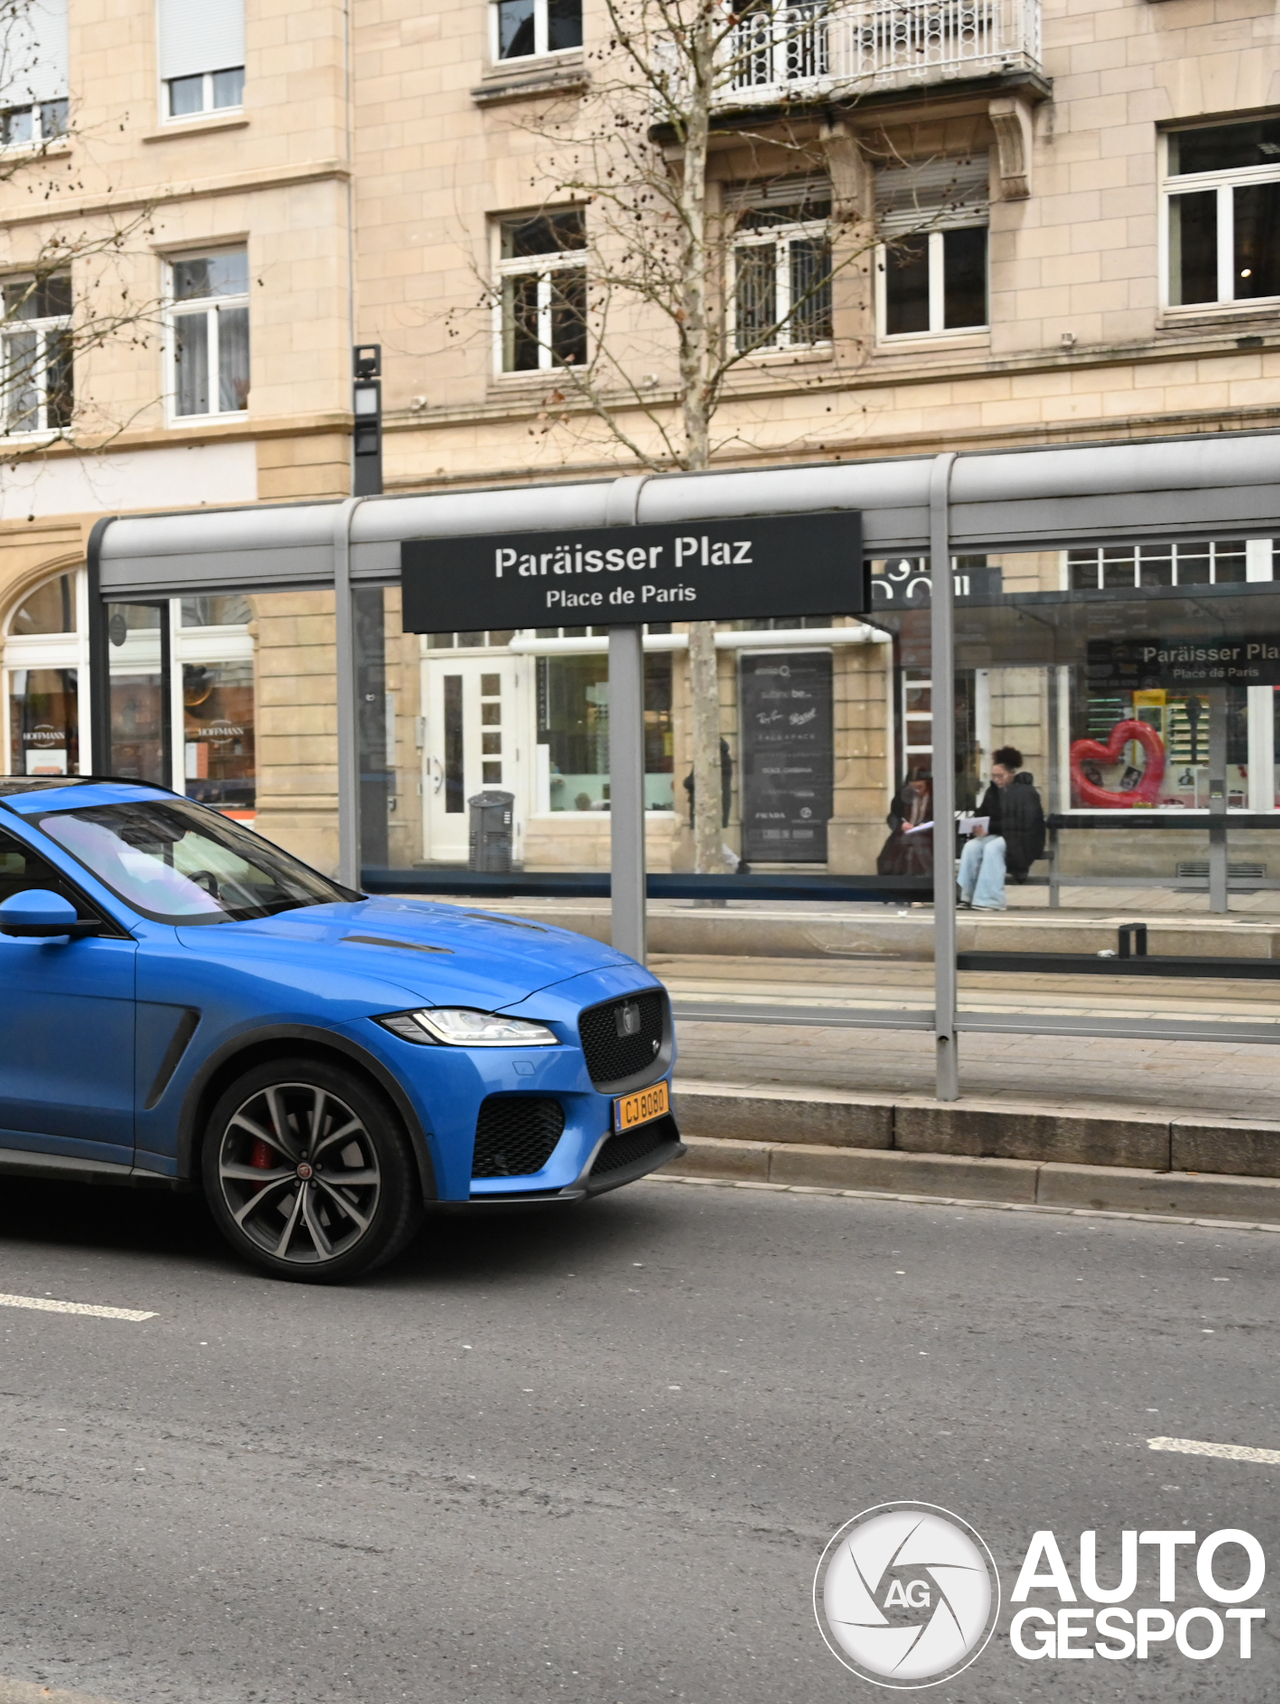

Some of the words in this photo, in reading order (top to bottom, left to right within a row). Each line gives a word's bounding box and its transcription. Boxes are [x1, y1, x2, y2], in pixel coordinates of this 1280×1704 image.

[494, 543, 663, 578] Paräisser
[674, 537, 754, 569] Plaz
[546, 589, 604, 608] Place
[608, 586, 636, 605] de
[641, 584, 697, 604] Paris
[1143, 645, 1241, 663] Paräisser
[1247, 643, 1280, 660] Pla
[1173, 668, 1207, 679] Place
[1227, 667, 1260, 678] Paris
[22, 731, 66, 740] HOFFMANN
[198, 726, 245, 736] HOFFMANN
[625, 1097, 640, 1124] CJ
[640, 1088, 665, 1118] 8080
